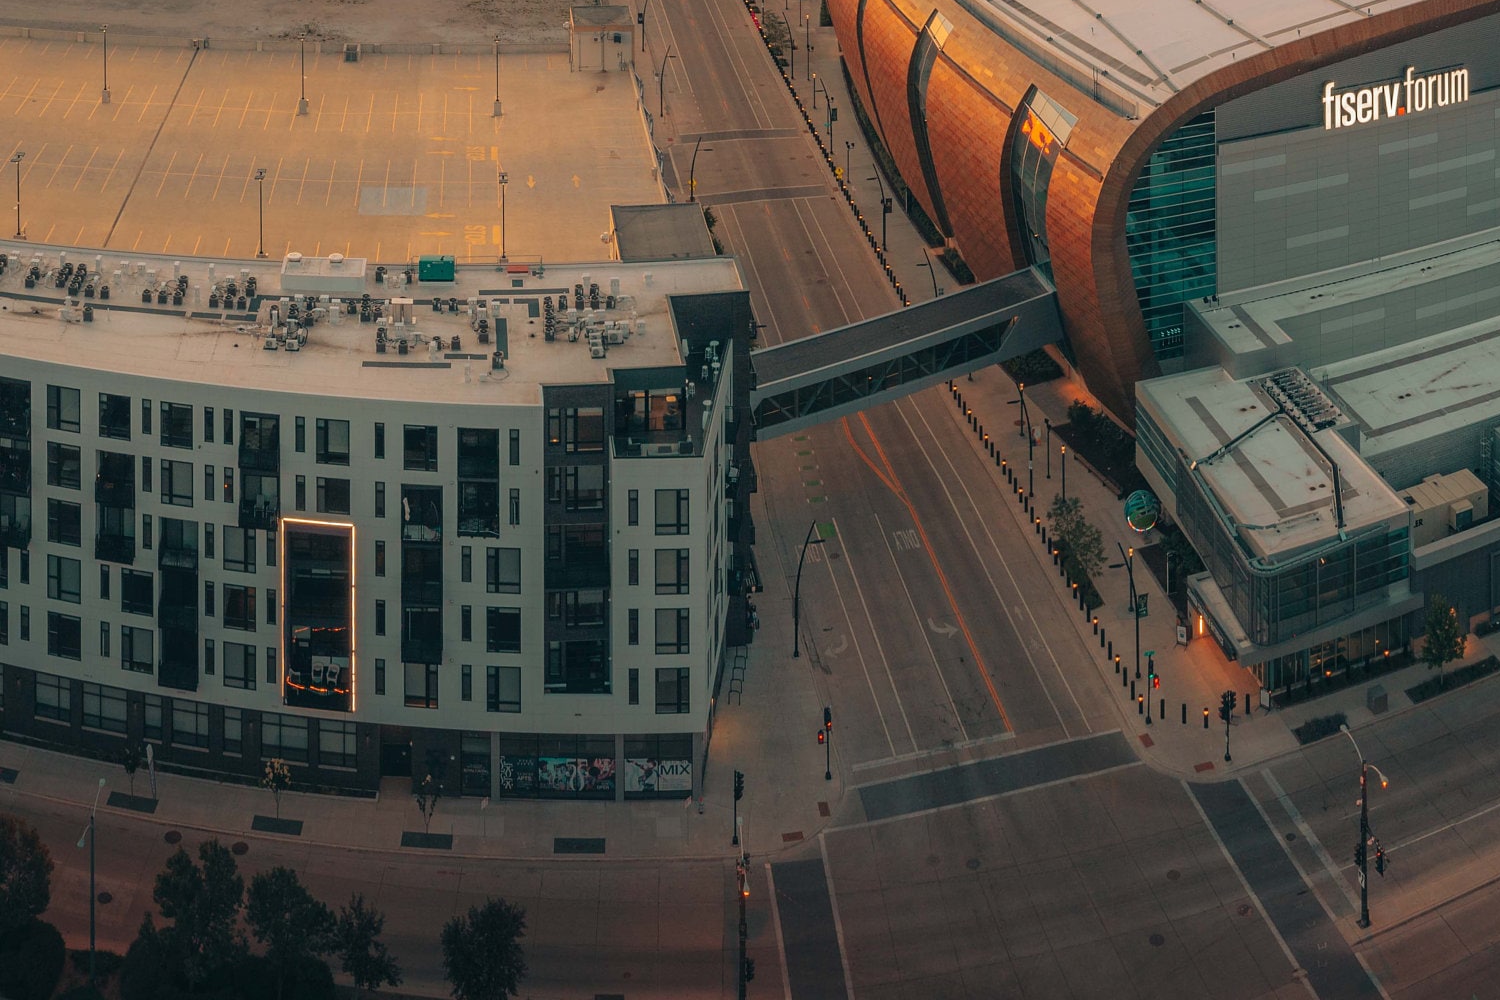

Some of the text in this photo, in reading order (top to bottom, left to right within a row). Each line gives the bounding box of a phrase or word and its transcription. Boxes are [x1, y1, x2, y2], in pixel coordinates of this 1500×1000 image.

[1322, 66, 1469, 130] fiserv.forum
[892, 529, 921, 551] ONLY
[660, 764, 690, 776] MIX
